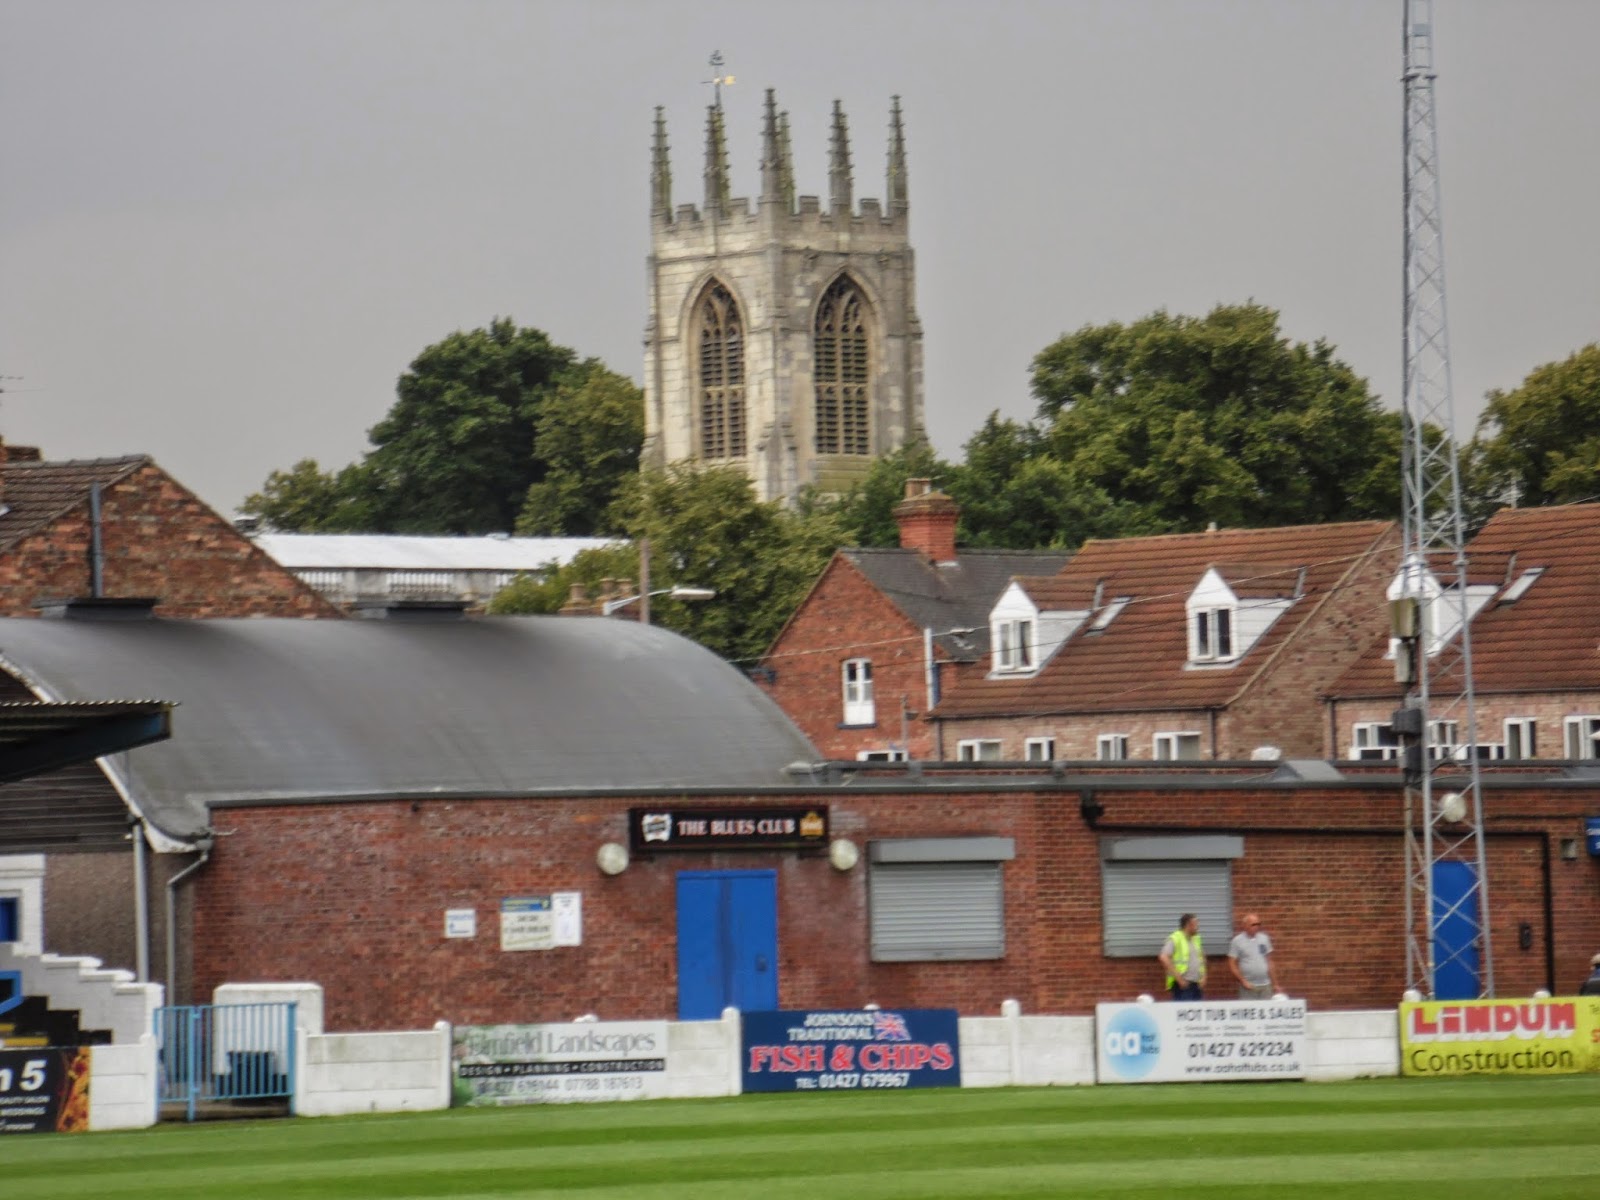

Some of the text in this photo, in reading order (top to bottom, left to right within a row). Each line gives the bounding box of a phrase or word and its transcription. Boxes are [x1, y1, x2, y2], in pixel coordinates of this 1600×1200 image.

[677, 819, 708, 836] THE
[711, 818, 755, 836] BLUES
[757, 817, 795, 835] CLUB
[1176, 1008, 1202, 1021] HOT
[1206, 1008, 1226, 1021] TUB
[1230, 1008, 1257, 1020] HIRE
[1269, 1007, 1304, 1020] SALES
[547, 1029, 655, 1056] Landscapes
[787, 1027, 874, 1042] TRADITIONAL
[749, 1042, 955, 1073] FISH & CHIPS
[1188, 1041, 1293, 1058] 01427 629234
[460, 1059, 664, 1077] DESIGN PLANNING CONSTRUCTION
[1410, 1045, 1574, 1073] Construction
[19, 1059, 47, 1091] 5
[818, 1072, 860, 1088] 01427
